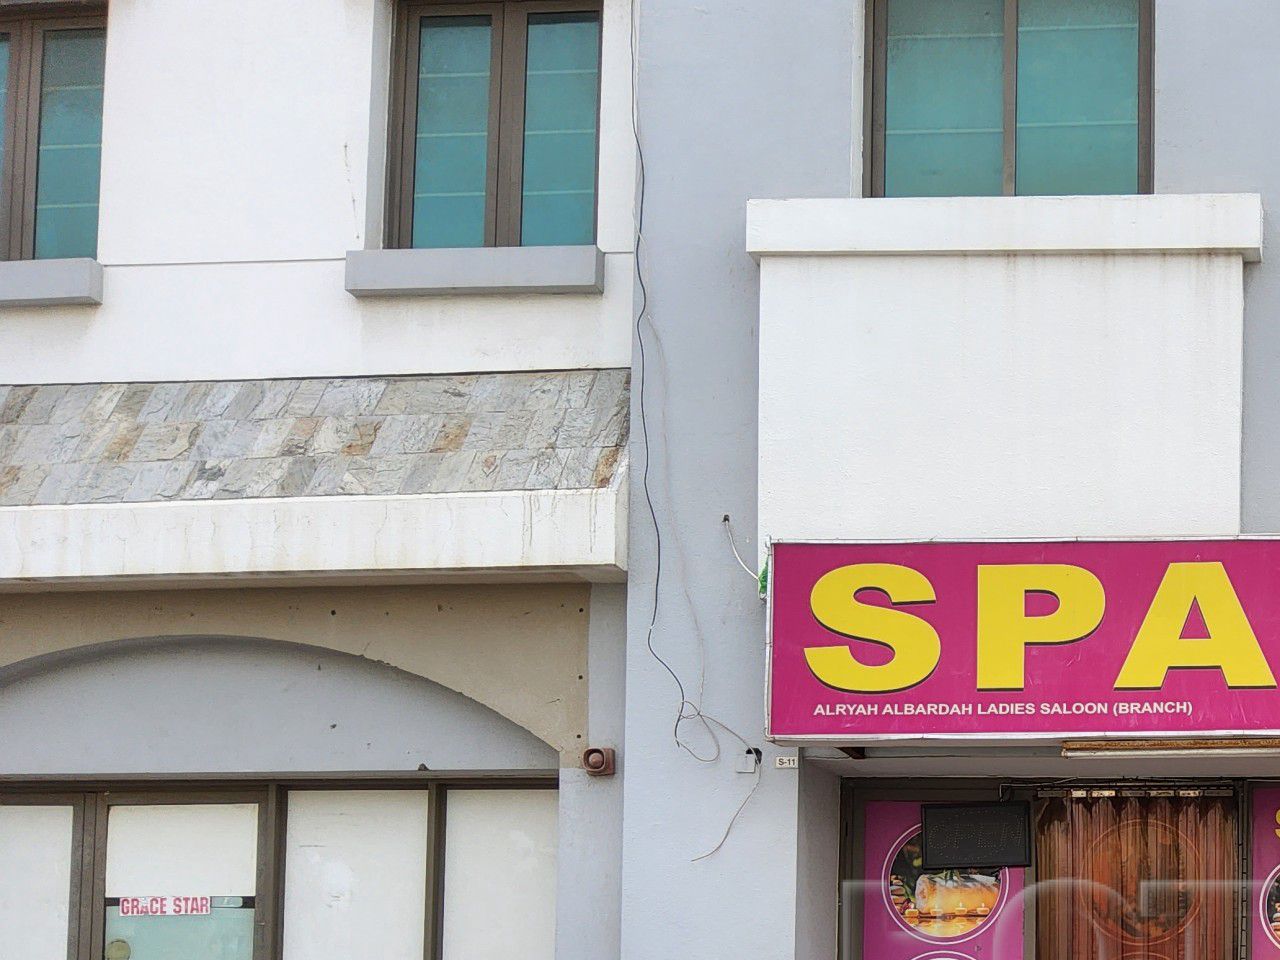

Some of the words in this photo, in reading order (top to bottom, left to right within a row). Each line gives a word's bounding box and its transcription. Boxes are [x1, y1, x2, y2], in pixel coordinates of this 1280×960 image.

[804, 561, 1277, 692] SPA
[813, 702, 878, 716] ALRYAH
[881, 702, 973, 716] ALBARDAH
[977, 702, 1036, 715] LADIES
[1039, 702, 1108, 715] SALOON
[1112, 701, 1193, 717] (BRANCH)
[778, 758, 796, 766] S-11
[172, 897, 209, 915] STAR
